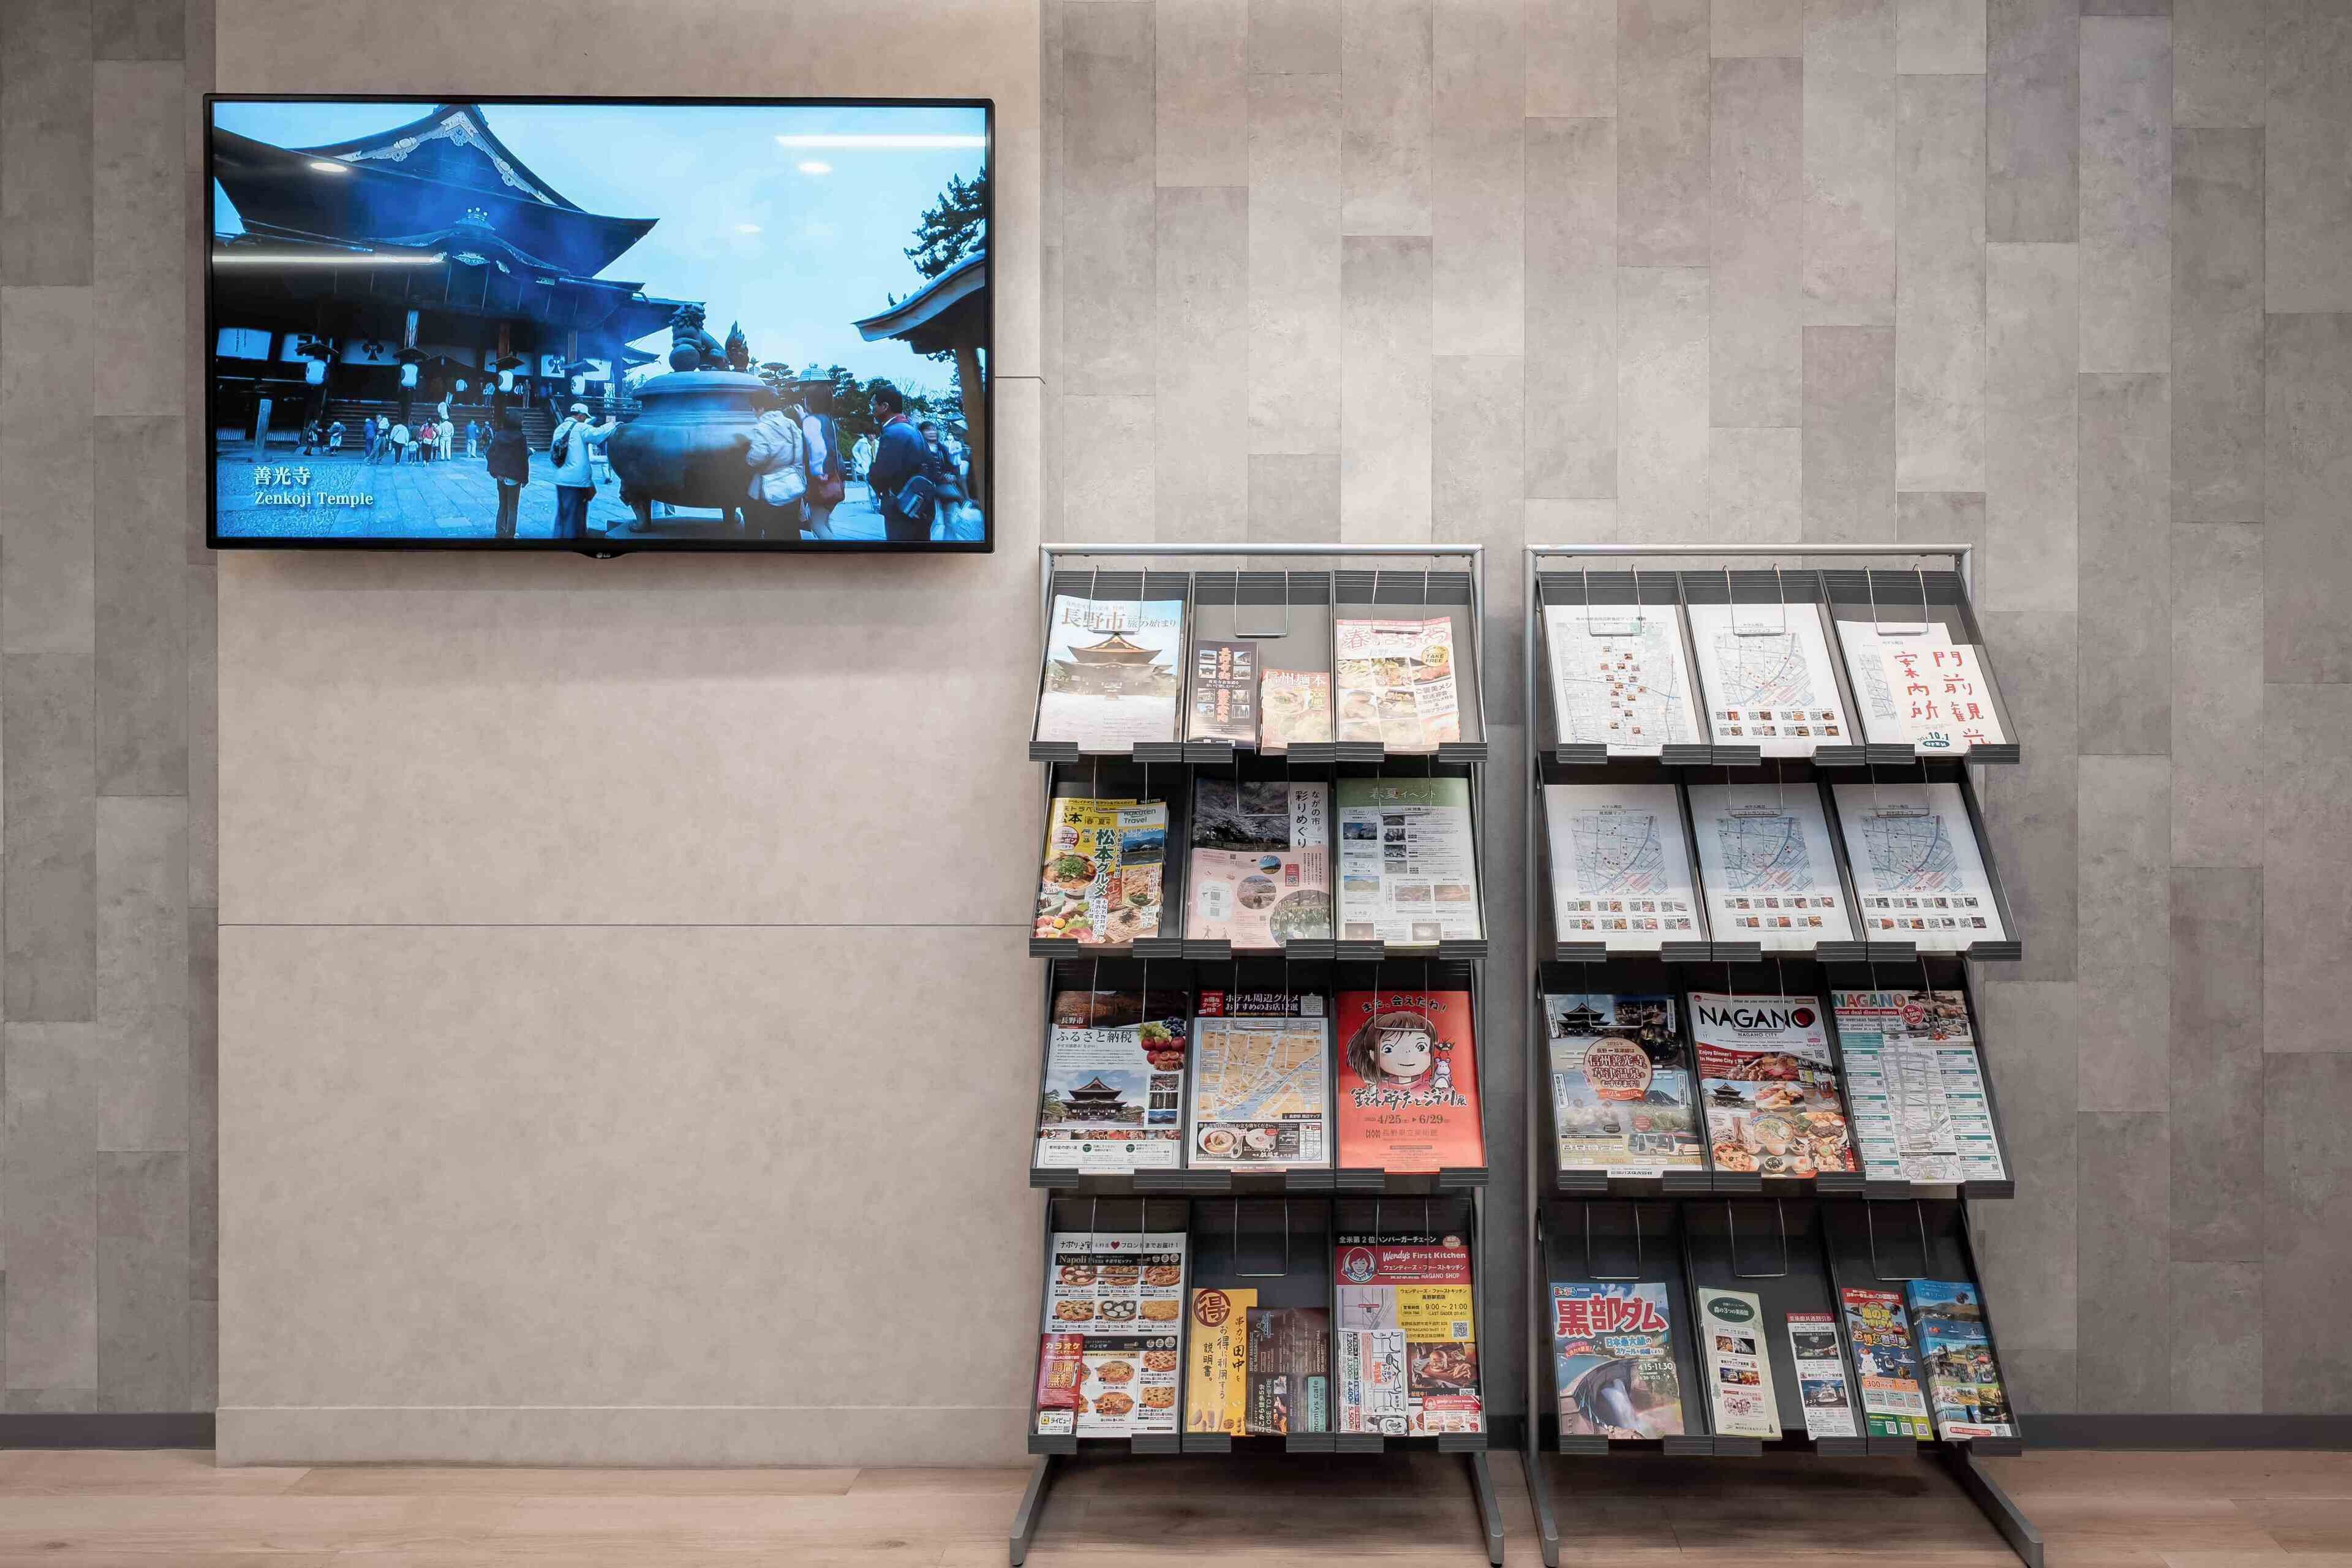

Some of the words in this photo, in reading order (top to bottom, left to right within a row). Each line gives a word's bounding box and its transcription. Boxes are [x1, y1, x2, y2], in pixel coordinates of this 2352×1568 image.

[254, 466, 311, 486] 善光寺
[254, 491, 312, 508] Zenkoji
[318, 491, 373, 508] Temple
[1061, 607, 1126, 630] 長野市
[1311, 791, 1321, 826] ながの市
[1295, 790, 1308, 848] 彩りめぐり
[1094, 827, 1116, 897] 松本グルメ
[1832, 993, 1905, 1008] NAGANO
[1698, 1005, 1816, 1029] NAGANO
[1056, 1031, 1133, 1043] ふるさと納税
[1378, 1114, 1401, 1124] 4/25
[1419, 1114, 1443, 1124] 6/29
[1059, 1254, 1087, 1265] Napoli
[1382, 1250, 1411, 1262] Wendy's
[1196, 1293, 1227, 1324] 得
[1555, 1293, 1670, 1338] 黒部ダム
[1266, 1399, 1272, 1409] TO
